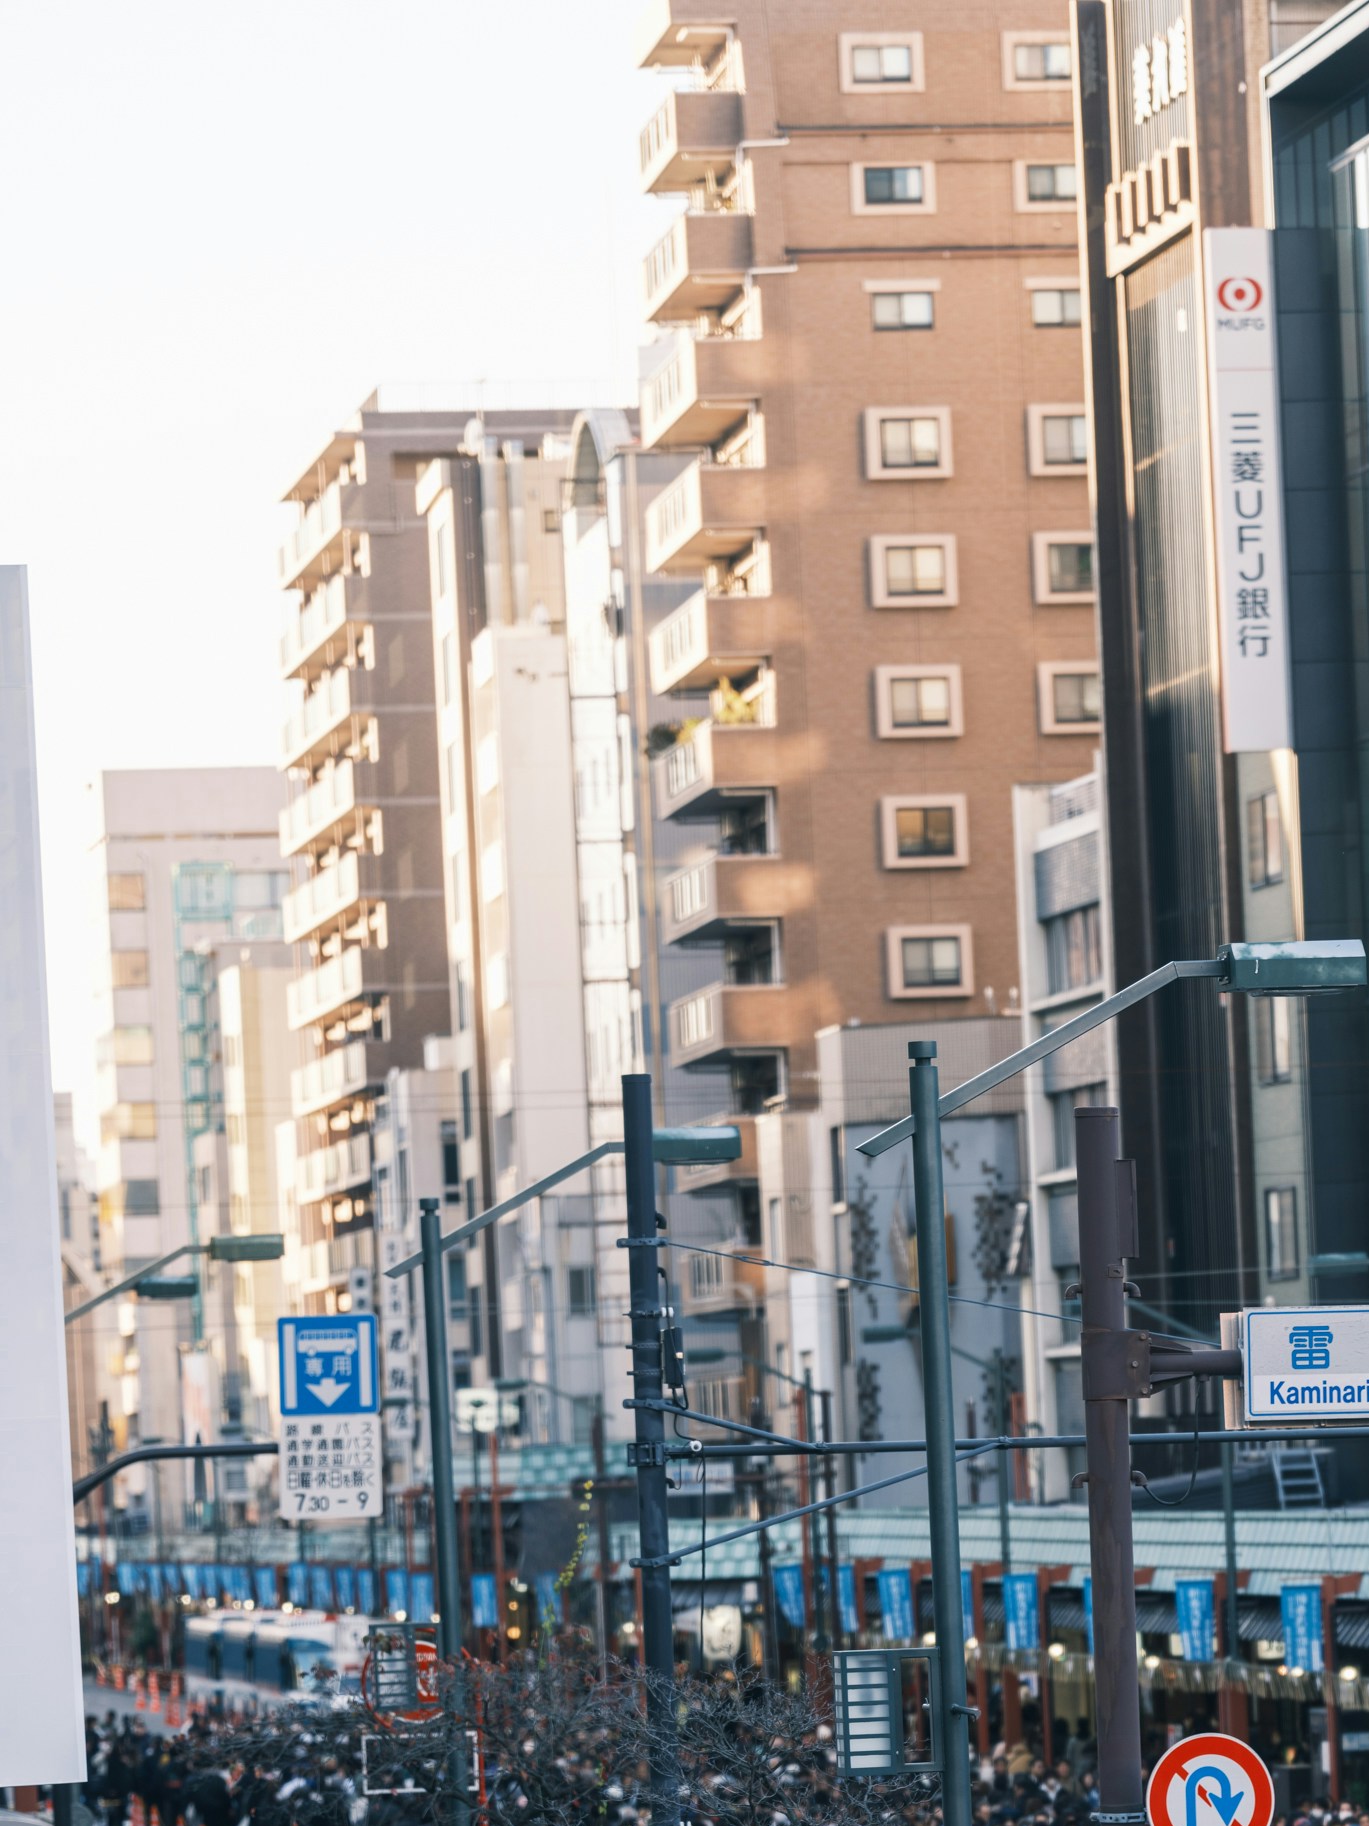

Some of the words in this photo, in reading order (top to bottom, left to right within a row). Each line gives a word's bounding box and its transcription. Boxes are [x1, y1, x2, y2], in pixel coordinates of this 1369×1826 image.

[1217, 318, 1266, 331] MUFG
[1231, 411, 1272, 658] 三菱UFJ銀行
[286, 1421, 374, 1437] 路線バス
